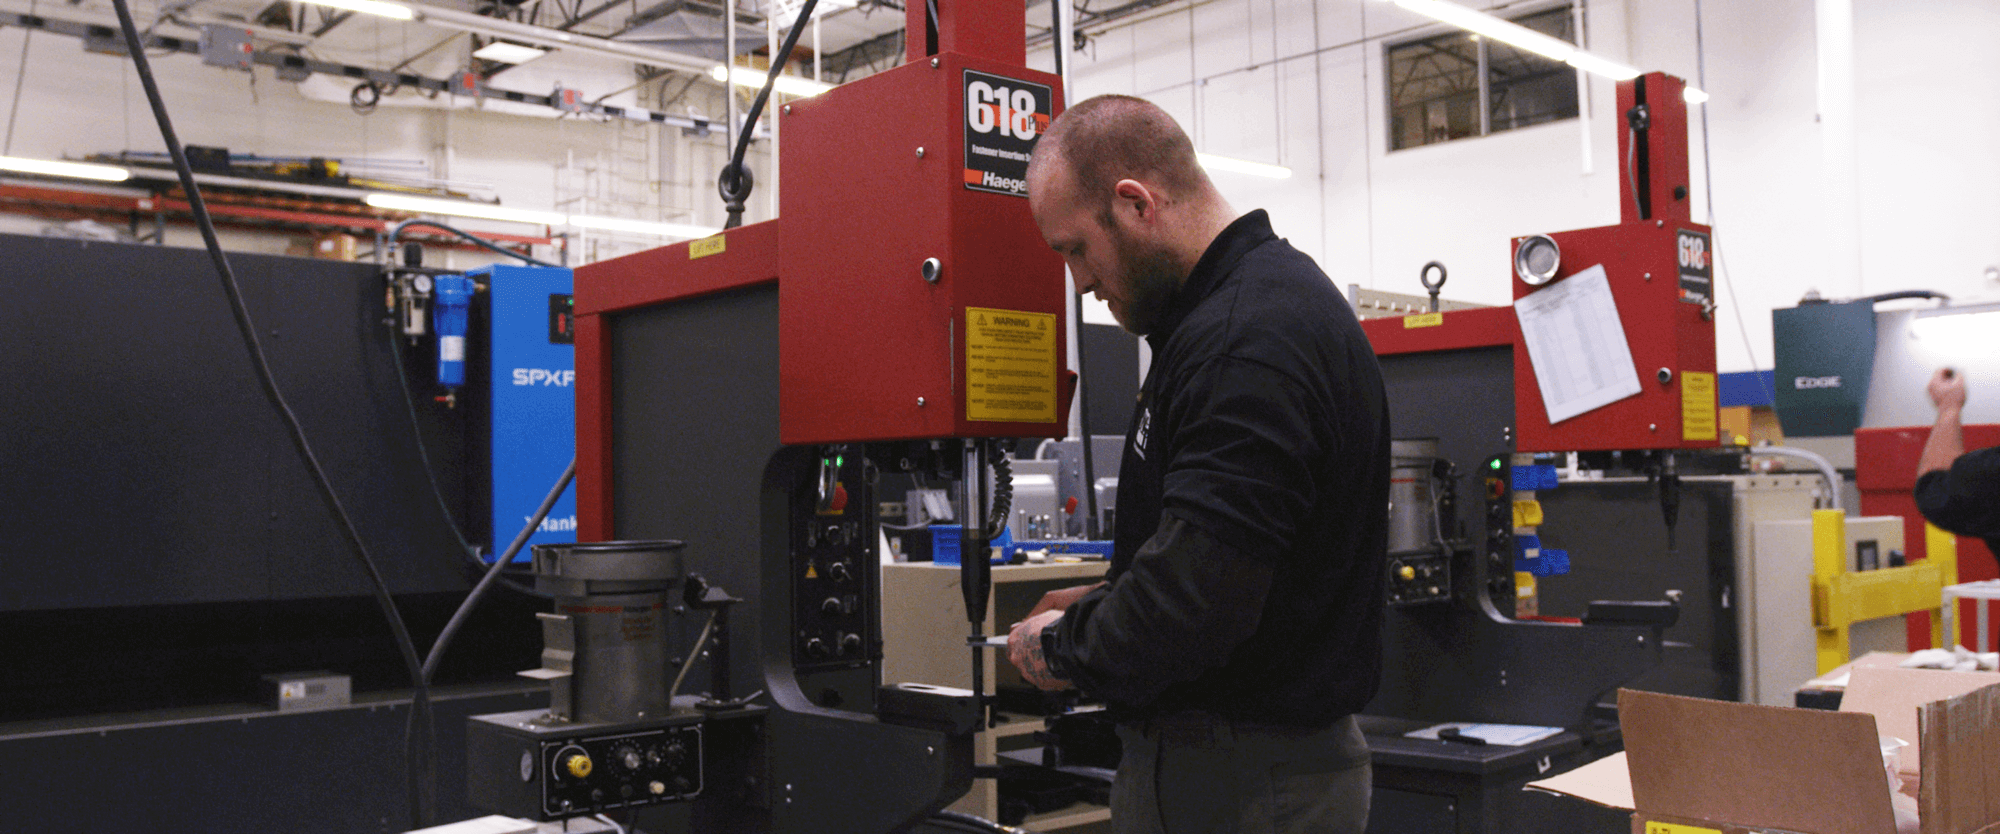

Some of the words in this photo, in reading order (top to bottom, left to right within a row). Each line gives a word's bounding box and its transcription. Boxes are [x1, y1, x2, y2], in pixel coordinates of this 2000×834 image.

[968, 80, 1036, 141] 618
[982, 171, 1027, 193] Haege
[1678, 234, 1705, 270] 618
[993, 317, 1030, 328] WARNING
[1795, 376, 1841, 389] EDGE
